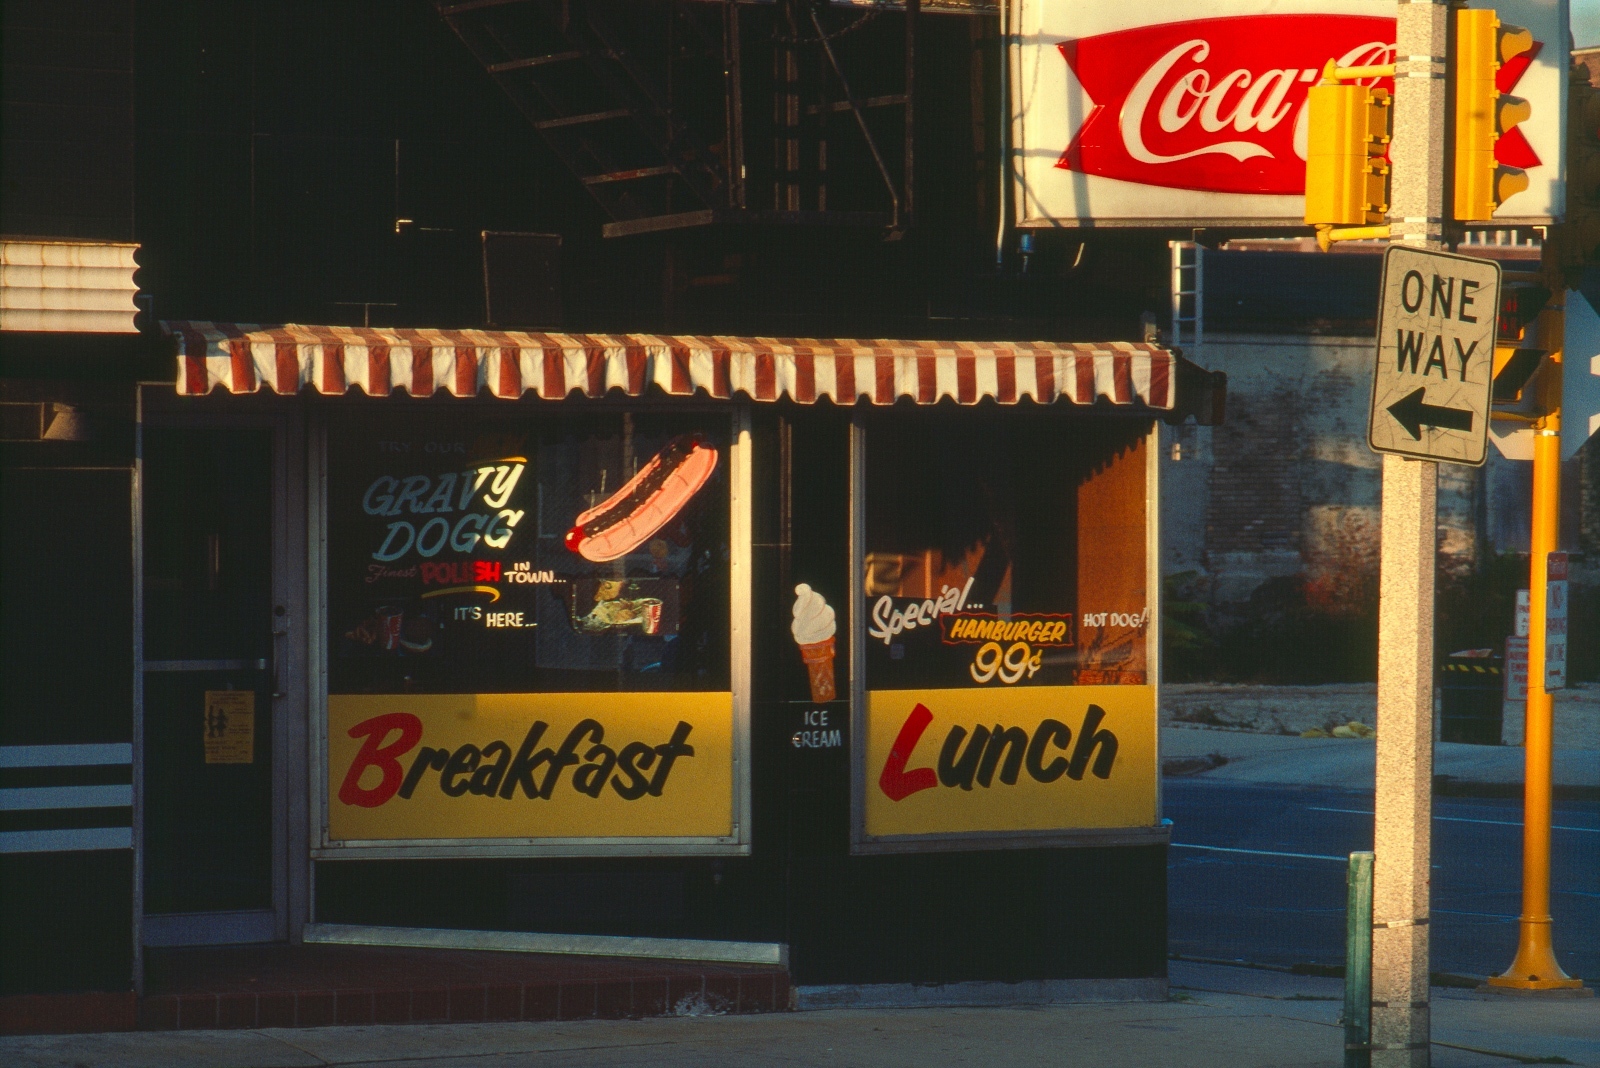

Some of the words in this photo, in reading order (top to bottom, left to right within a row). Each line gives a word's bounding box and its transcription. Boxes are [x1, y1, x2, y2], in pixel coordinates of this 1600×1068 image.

[1401, 268, 1480, 325] ONE
[1397, 327, 1478, 384] WAY
[377, 440, 412, 454] TRY
[424, 440, 466, 454] OUR
[362, 463, 526, 517] GRAVY
[371, 508, 526, 562] DOGG
[364, 564, 418, 584] Finest
[420, 559, 502, 585] POLISH
[503, 570, 567, 584] TOWN...
[513, 561, 531, 572] IN
[454, 606, 482, 621] IT'S
[868, 577, 983, 645] Special...
[1083, 613, 1108, 628] HOT
[949, 617, 1068, 643] HAMBURGER
[970, 641, 1043, 684] 99¢
[803, 710, 829, 726] ICE
[791, 729, 842, 748] CREAM
[338, 712, 695, 808] Breakfast
[878, 702, 1119, 802] Lunch
